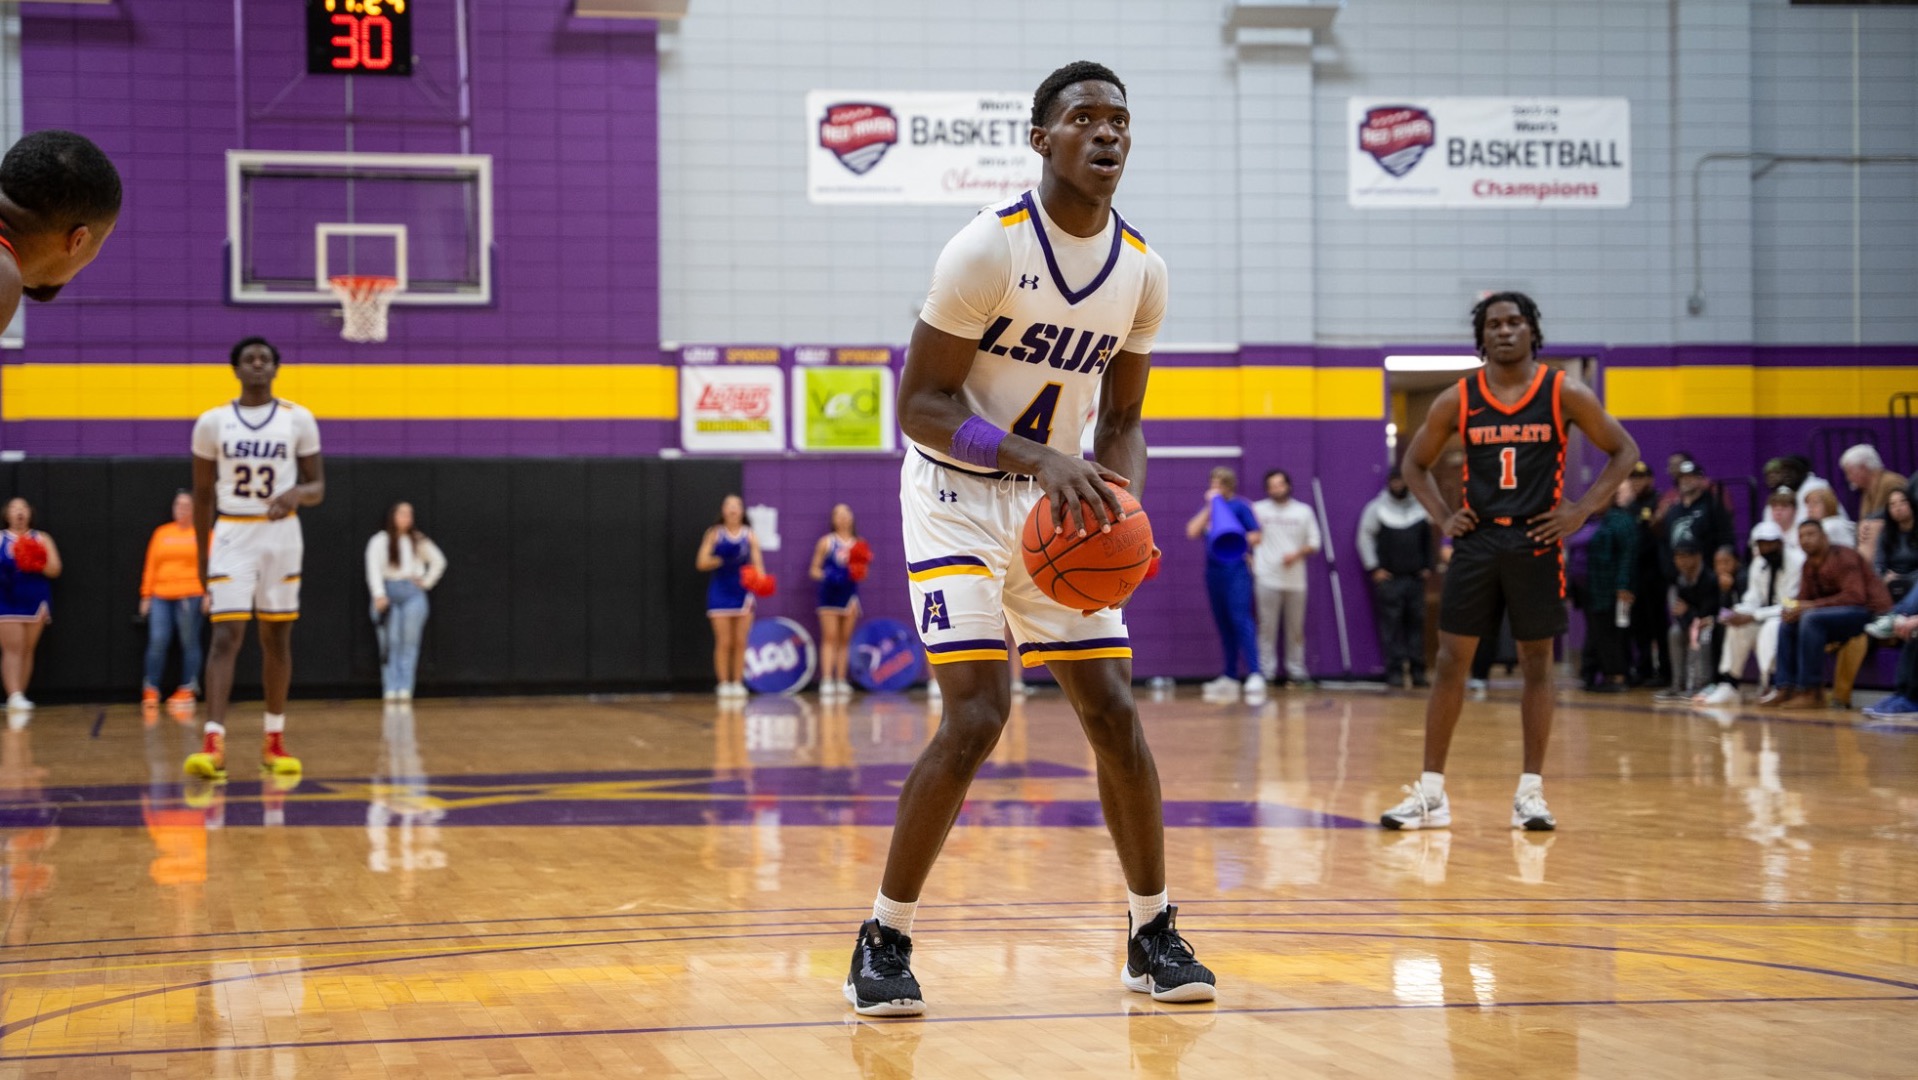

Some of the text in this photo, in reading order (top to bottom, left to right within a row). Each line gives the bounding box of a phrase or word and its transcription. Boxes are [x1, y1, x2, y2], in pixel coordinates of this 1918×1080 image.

[330, 13, 393, 70] 30
[1448, 138, 1623, 168] BASKETBALL
[1472, 179, 1600, 200] Champions
[978, 315, 1119, 375] LSUA
[1010, 380, 1065, 447] 4
[222, 440, 287, 460] LSUA
[1467, 423, 1552, 445] WILDCATS
[233, 464, 275, 500] 23
[1499, 447, 1517, 490] 1
